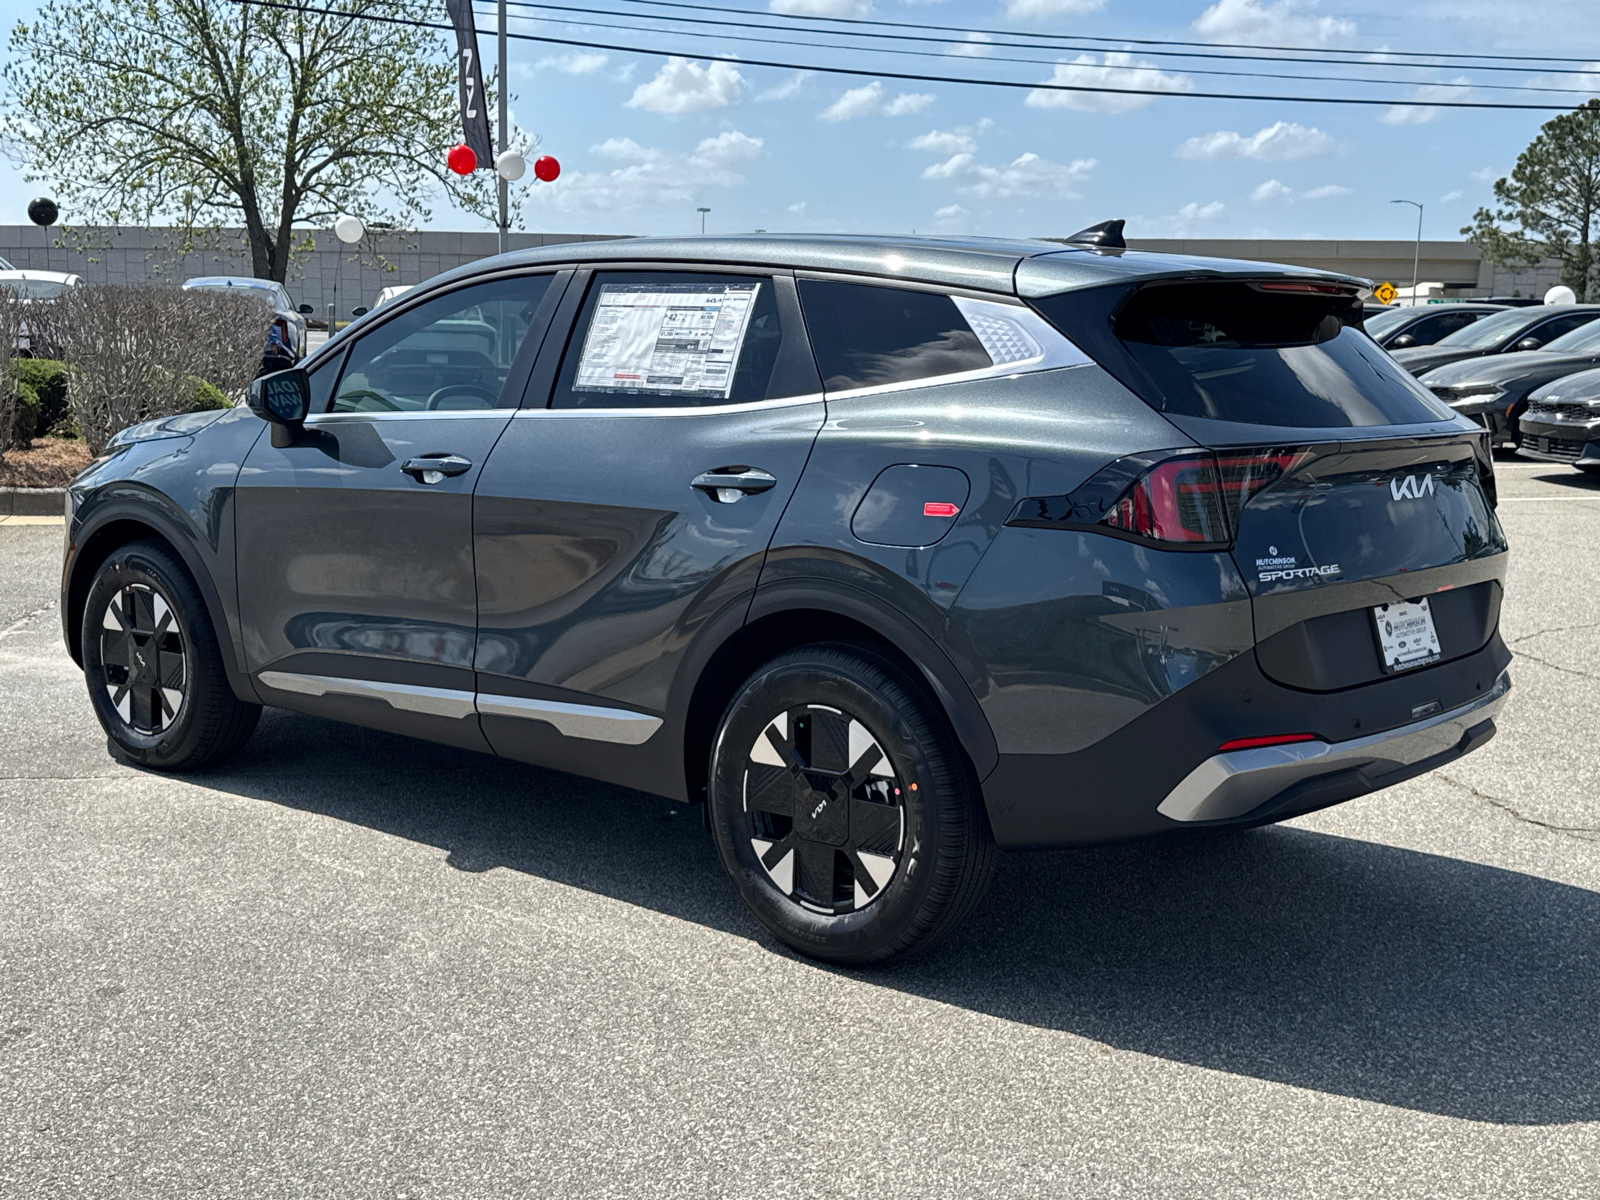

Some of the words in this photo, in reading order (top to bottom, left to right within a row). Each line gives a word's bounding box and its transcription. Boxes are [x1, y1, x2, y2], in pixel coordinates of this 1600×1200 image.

[668, 313, 678, 321] 42
[1390, 473, 1434, 501] KIA
[1256, 557, 1296, 566] HUTCHINSON
[1259, 564, 1341, 582] SPORTAGE
[1393, 617, 1427, 632] HUTCHINSON
